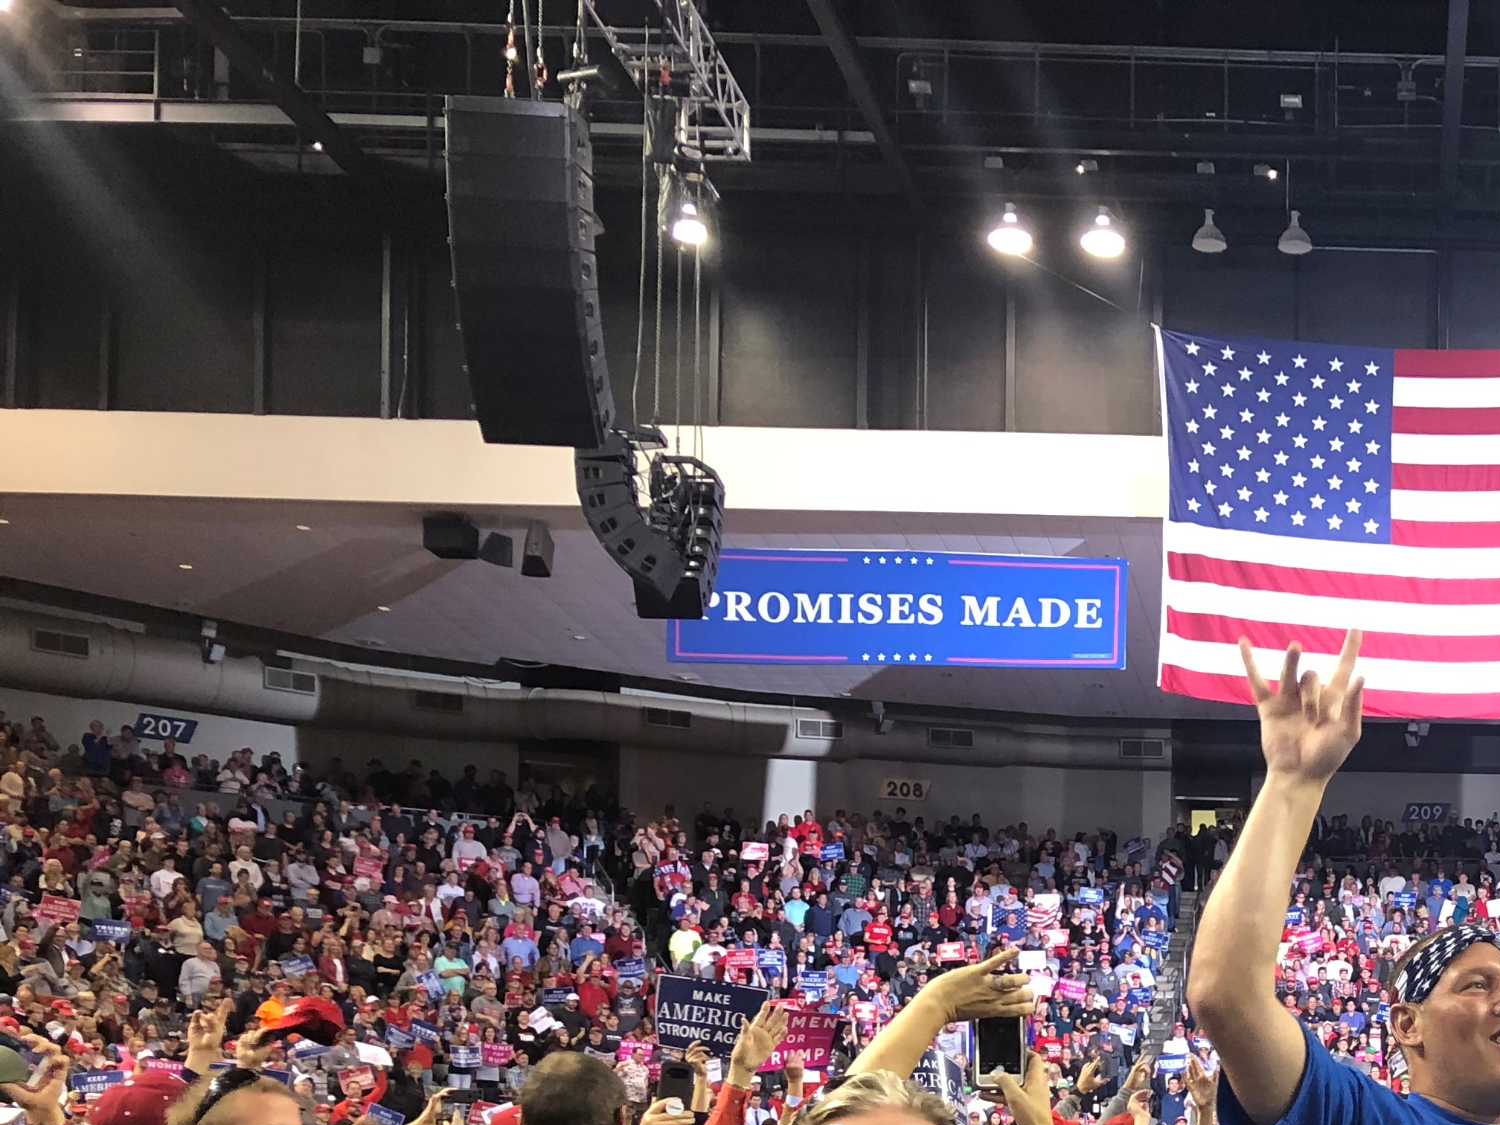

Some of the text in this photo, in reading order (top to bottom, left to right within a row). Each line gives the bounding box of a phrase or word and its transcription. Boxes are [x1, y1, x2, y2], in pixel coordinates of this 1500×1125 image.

[960, 595, 1104, 629] MADE
[143, 716, 187, 737] 207
[887, 780, 923, 798] 208
[1409, 805, 1442, 820] 209
[692, 989, 732, 1006] MAKE
[657, 1001, 747, 1030] AMERIC
[791, 1016, 838, 1029] MEN
[658, 1022, 711, 1041] STRONG
[786, 1033, 806, 1044] OR
